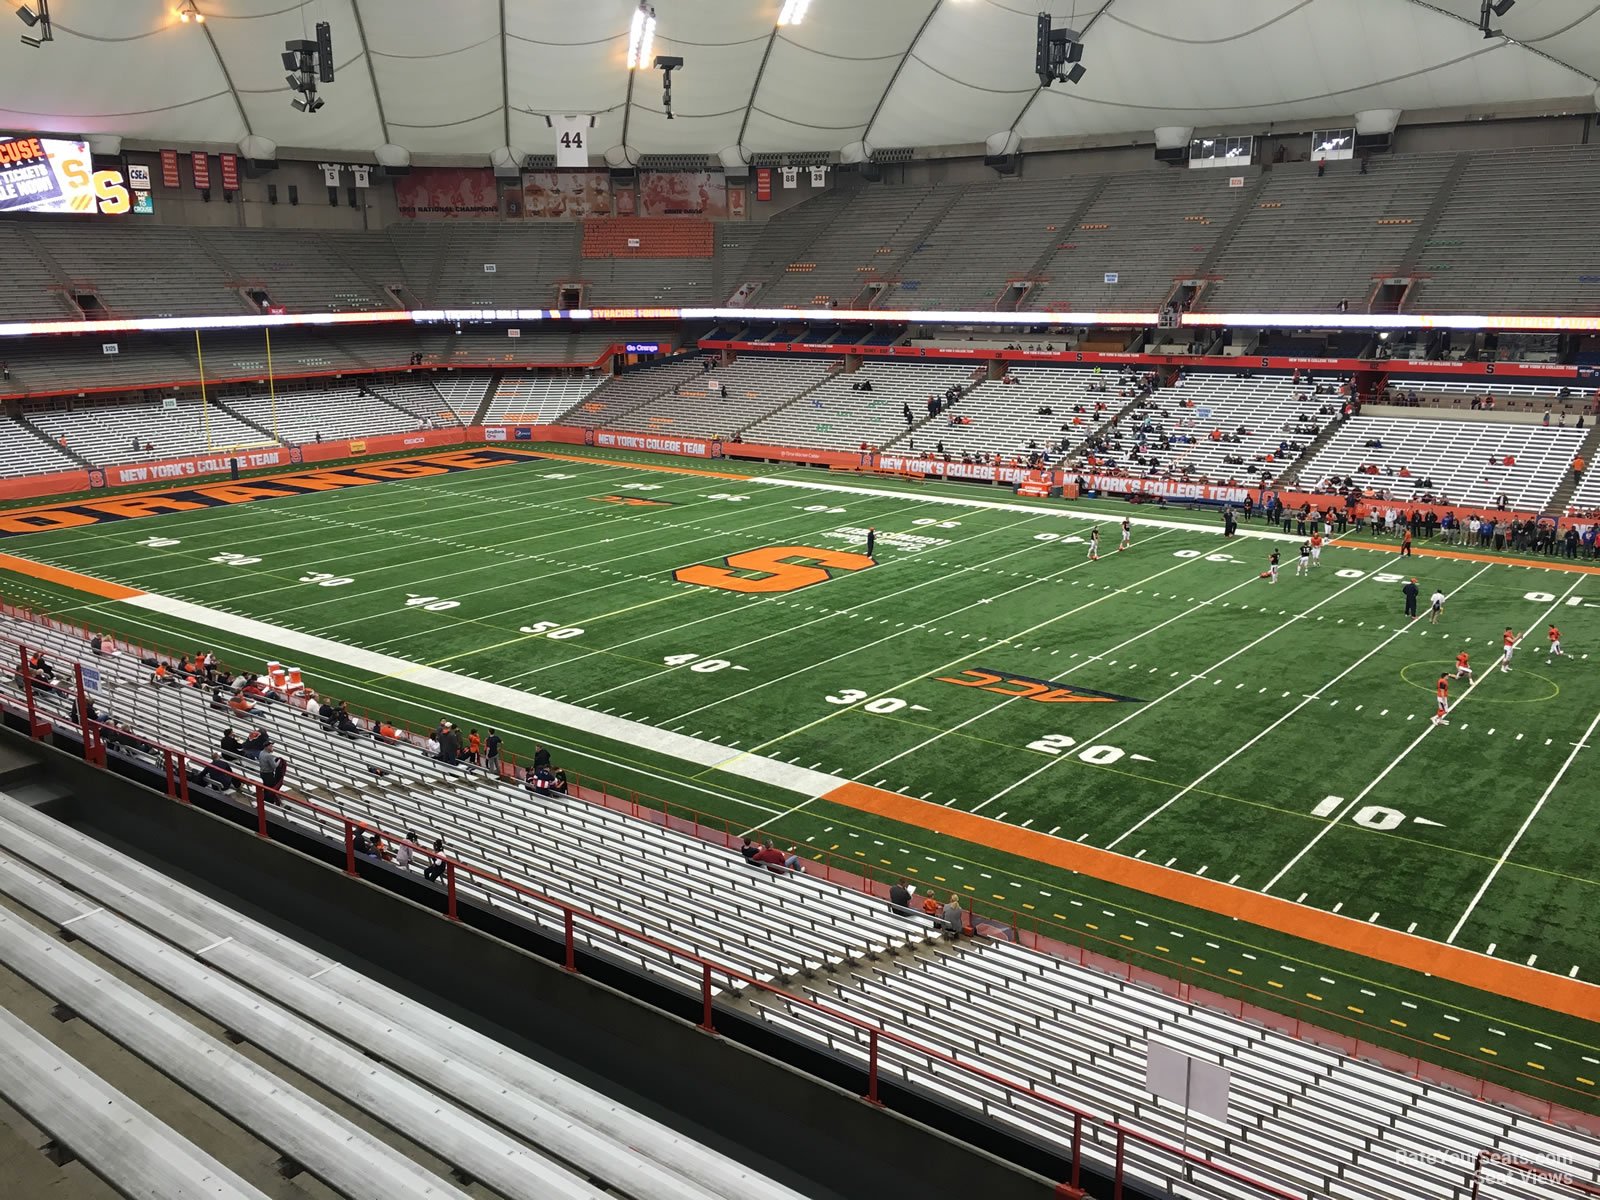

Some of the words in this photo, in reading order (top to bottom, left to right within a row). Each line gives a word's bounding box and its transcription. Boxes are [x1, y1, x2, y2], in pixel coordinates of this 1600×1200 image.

[560, 131, 583, 149] 44
[329, 172, 335, 180] 5
[359, 173, 365, 181] 9
[785, 174, 795, 182] 88
[813, 173, 823, 181] 39
[91, 170, 131, 214] S
[592, 309, 637, 318] SYRACUSE
[636, 344, 658, 352] Orange
[1261, 358, 1269, 367] S
[1486, 363, 1495, 374] S
[598, 433, 615, 445] NEW
[616, 435, 645, 449] YORK'S
[646, 439, 680, 452] COLLEGE
[682, 442, 706, 455] TEAM
[289, 447, 301, 463] S
[119, 468, 147, 483] NEW
[149, 461, 195, 479] YORK'S
[248, 452, 279, 466] TEAM
[879, 457, 902, 469] NEW
[904, 459, 944, 475] YORK'S
[946, 463, 996, 480] COLLEGE
[89, 471, 104, 488] S
[0, 452, 519, 533] ORANGE
[1094, 475, 1141, 493] YORK'S
[1144, 479, 1204, 500] COLLEGE
[1208, 485, 1249, 502] TEAM
[803, 505, 847, 514] 40
[911, 518, 962, 529] 50
[136, 537, 181, 547] 10
[1033, 533, 1085, 544] 40
[208, 553, 262, 566] 20
[1173, 549, 1234, 562] 30
[672, 546, 879, 594] S
[1334, 568, 1405, 583] 20
[299, 573, 354, 587] 30
[404, 596, 461, 611] 40
[1523, 591, 1583, 606] 10
[519, 621, 585, 639] 50
[663, 652, 731, 673] 40
[824, 689, 908, 714] 30
[1025, 734, 1126, 765] 20
[1310, 795, 1407, 831] 10
